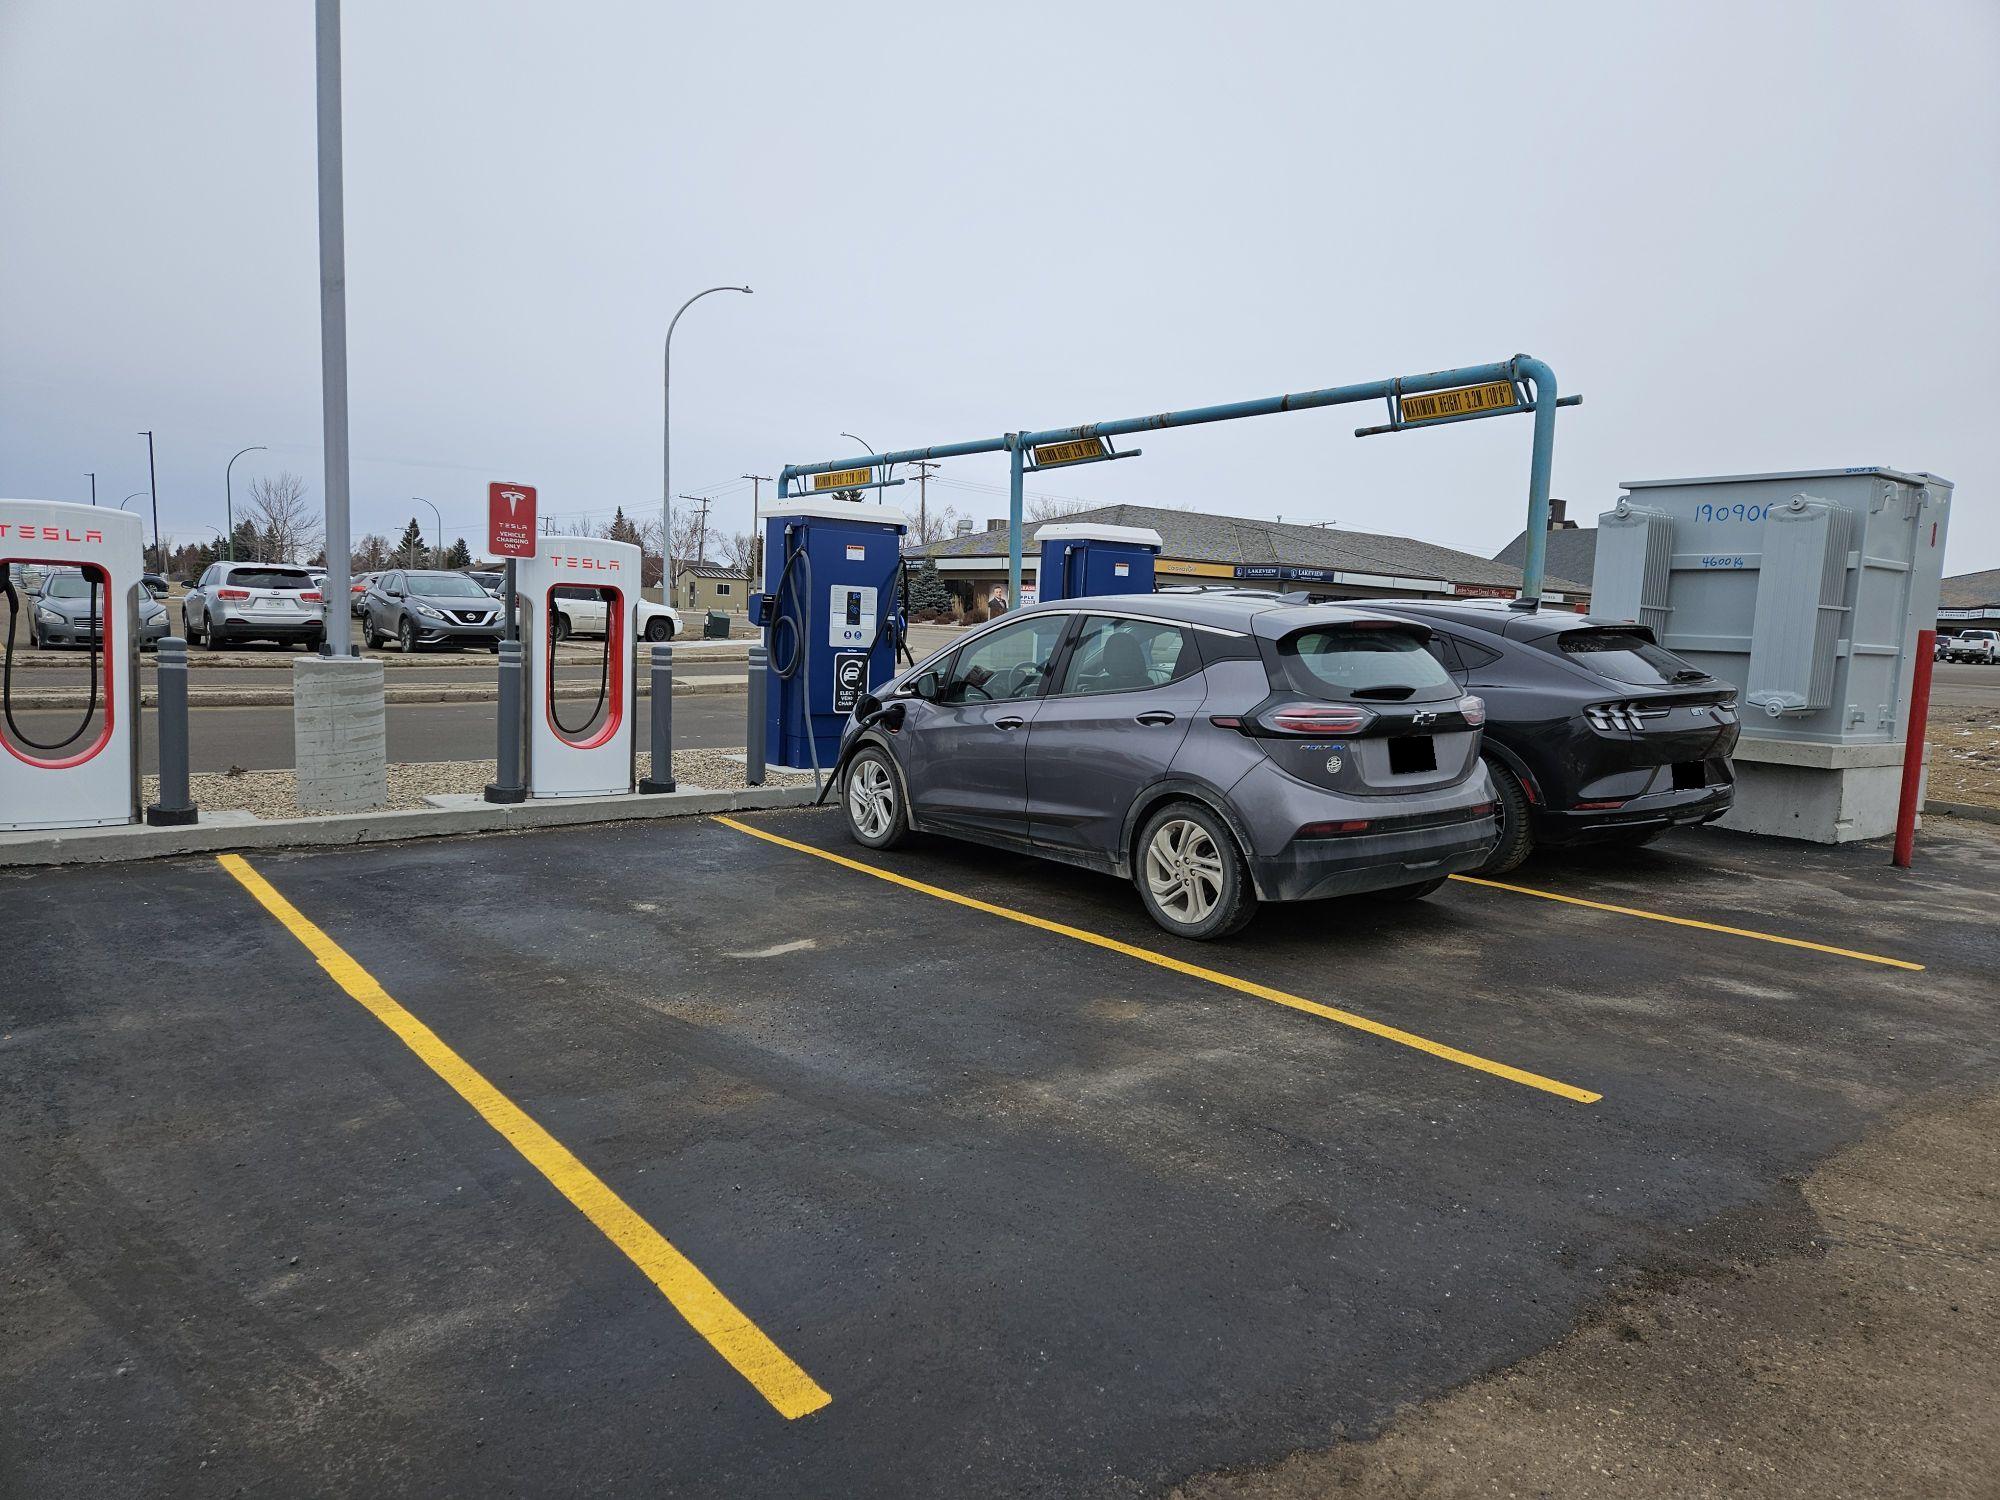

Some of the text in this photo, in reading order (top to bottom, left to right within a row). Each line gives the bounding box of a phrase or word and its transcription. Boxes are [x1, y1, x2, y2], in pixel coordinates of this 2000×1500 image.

[1404, 397, 1437, 417] MAXIMUM
[1439, 393, 1463, 413] HEIGHT
[1465, 389, 1483, 409] 3.2M
[499, 522, 528, 530] TESLA
[0, 524, 102, 543] TESLA
[500, 531, 526, 539] VEHICLE
[496, 537, 529, 545] CHARGING
[550, 556, 620, 571] TESLA
[1702, 557, 1731, 568] 4600
